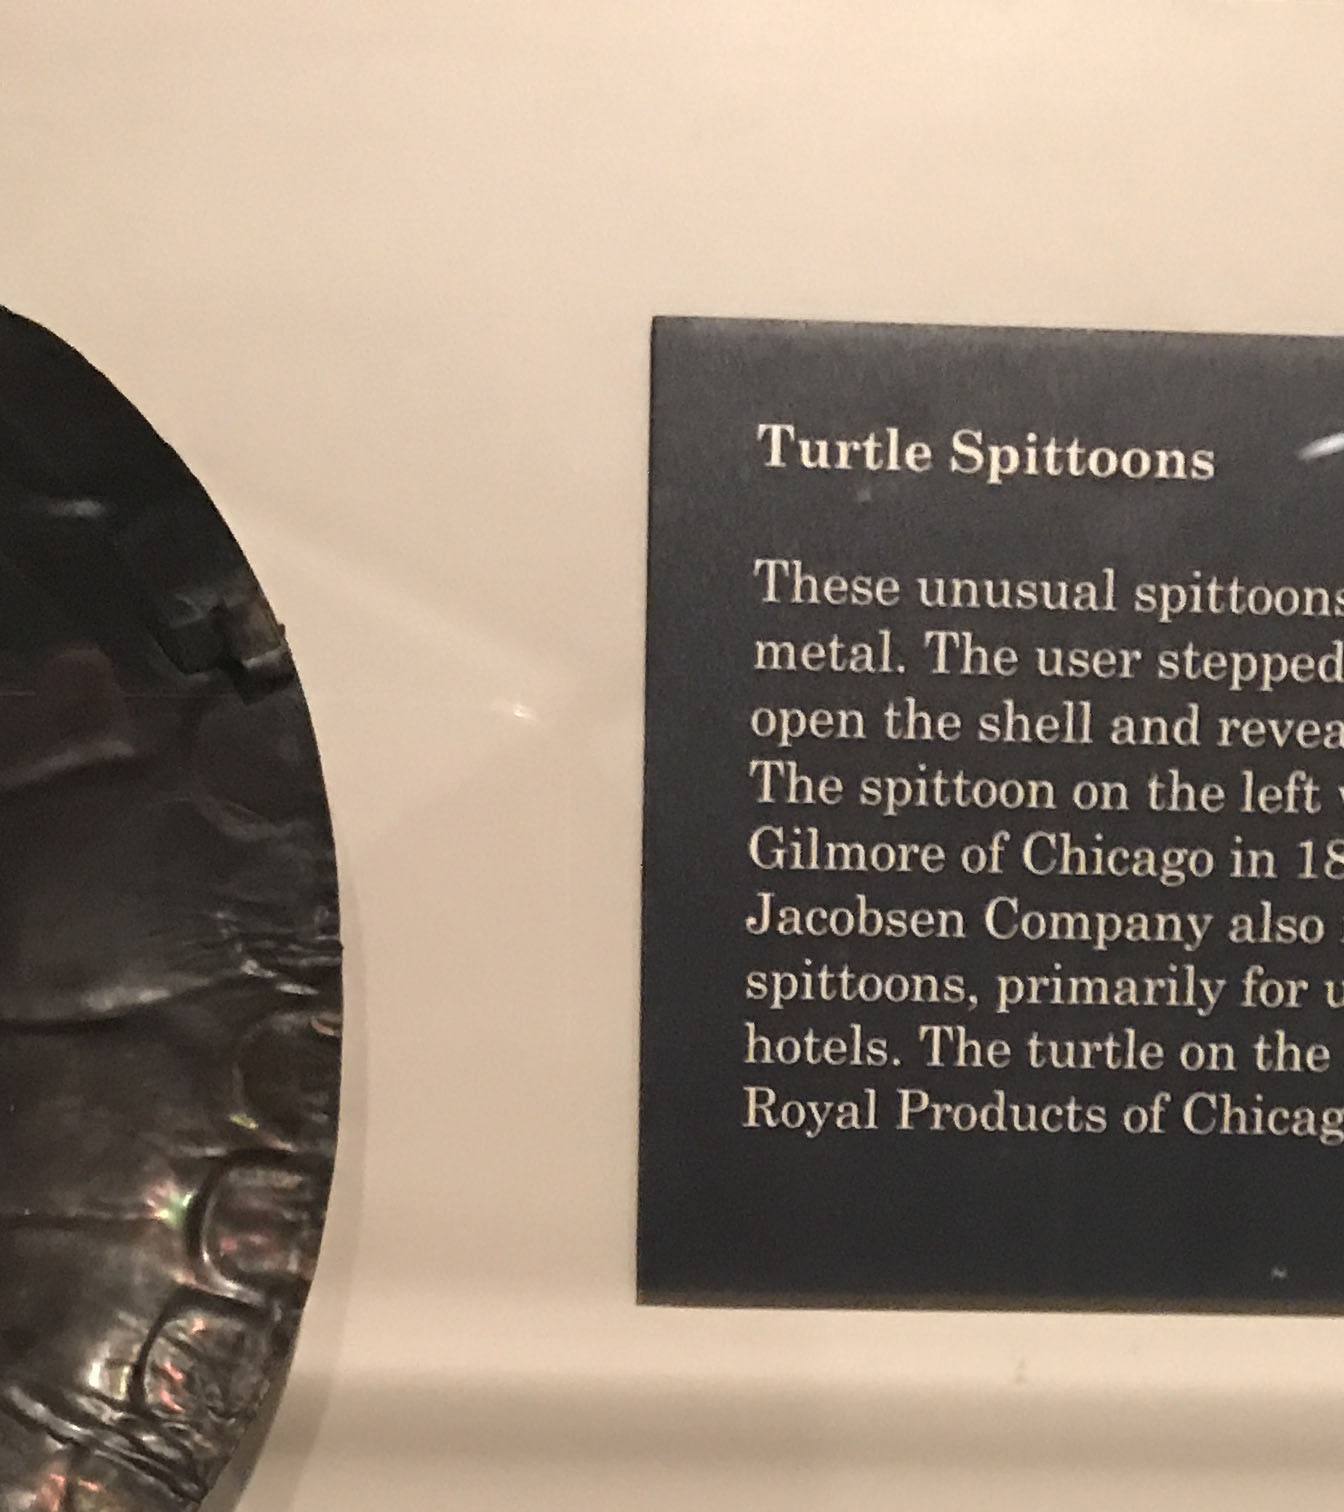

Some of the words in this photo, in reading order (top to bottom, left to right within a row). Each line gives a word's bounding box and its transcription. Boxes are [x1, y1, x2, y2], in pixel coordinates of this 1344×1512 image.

[755, 422, 934, 475] Turtle
[948, 427, 1216, 486] Spittoons
[752, 557, 902, 607] These
[915, 566, 1118, 613] unusual
[753, 627, 907, 675] metal.
[922, 629, 1020, 677] The
[1034, 646, 1143, 680] user
[749, 706, 868, 749] open
[882, 694, 963, 743] the
[976, 697, 1094, 746] shell
[1109, 701, 1202, 747] and
[747, 757, 845, 806] The
[858, 762, 1058, 817] spittoon
[1071, 780, 1130, 812] on
[1146, 767, 1227, 814] the
[1239, 768, 1323, 816] left
[747, 823, 947, 875] Gilmore
[959, 829, 1012, 875] of
[1021, 829, 1216, 888] Chicago
[1229, 834, 1278, 880] in
[743, 890, 968, 940] Jacobsen
[982, 894, 1215, 953] Company
[1226, 899, 1326, 945] also
[744, 956, 980, 1011] spittoons,
[995, 961, 1228, 1018] primarily
[1240, 963, 1310, 1009] for
[742, 1020, 902, 1068] hotels.
[917, 1023, 1012, 1070] The
[1026, 1026, 1166, 1071] turtle
[1178, 1041, 1238, 1072] on
[1251, 1027, 1332, 1074] the
[741, 1084, 880, 1140] Royal
[894, 1087, 1109, 1134] Products
[1121, 1090, 1173, 1135] of
